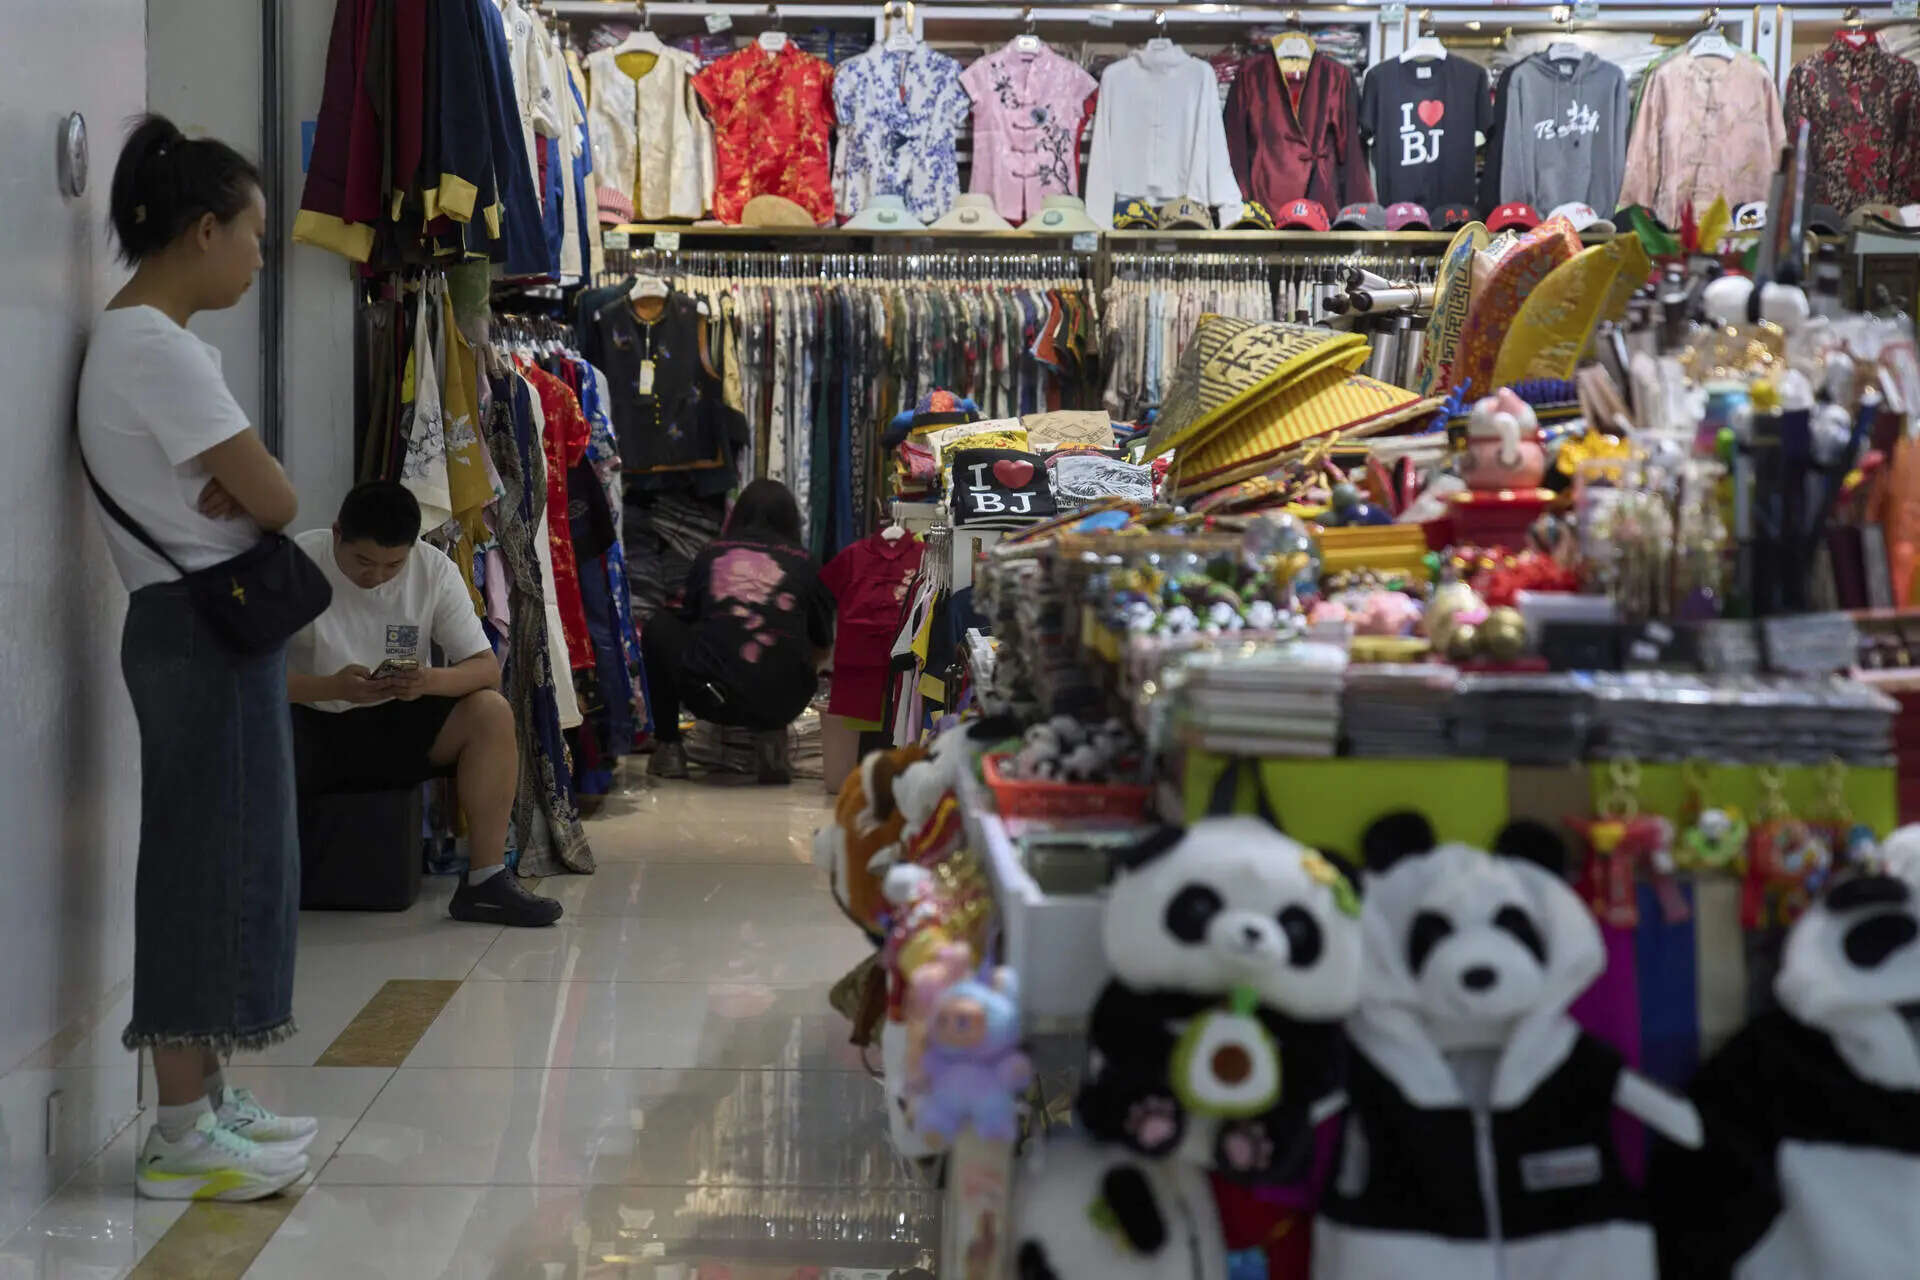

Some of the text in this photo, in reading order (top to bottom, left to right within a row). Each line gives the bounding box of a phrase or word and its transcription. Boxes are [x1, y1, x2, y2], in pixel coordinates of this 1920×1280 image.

[1400, 102, 1415, 132] I
[1400, 129, 1444, 166] BJ
[968, 462, 992, 491] I
[970, 491, 1037, 513] BJ
